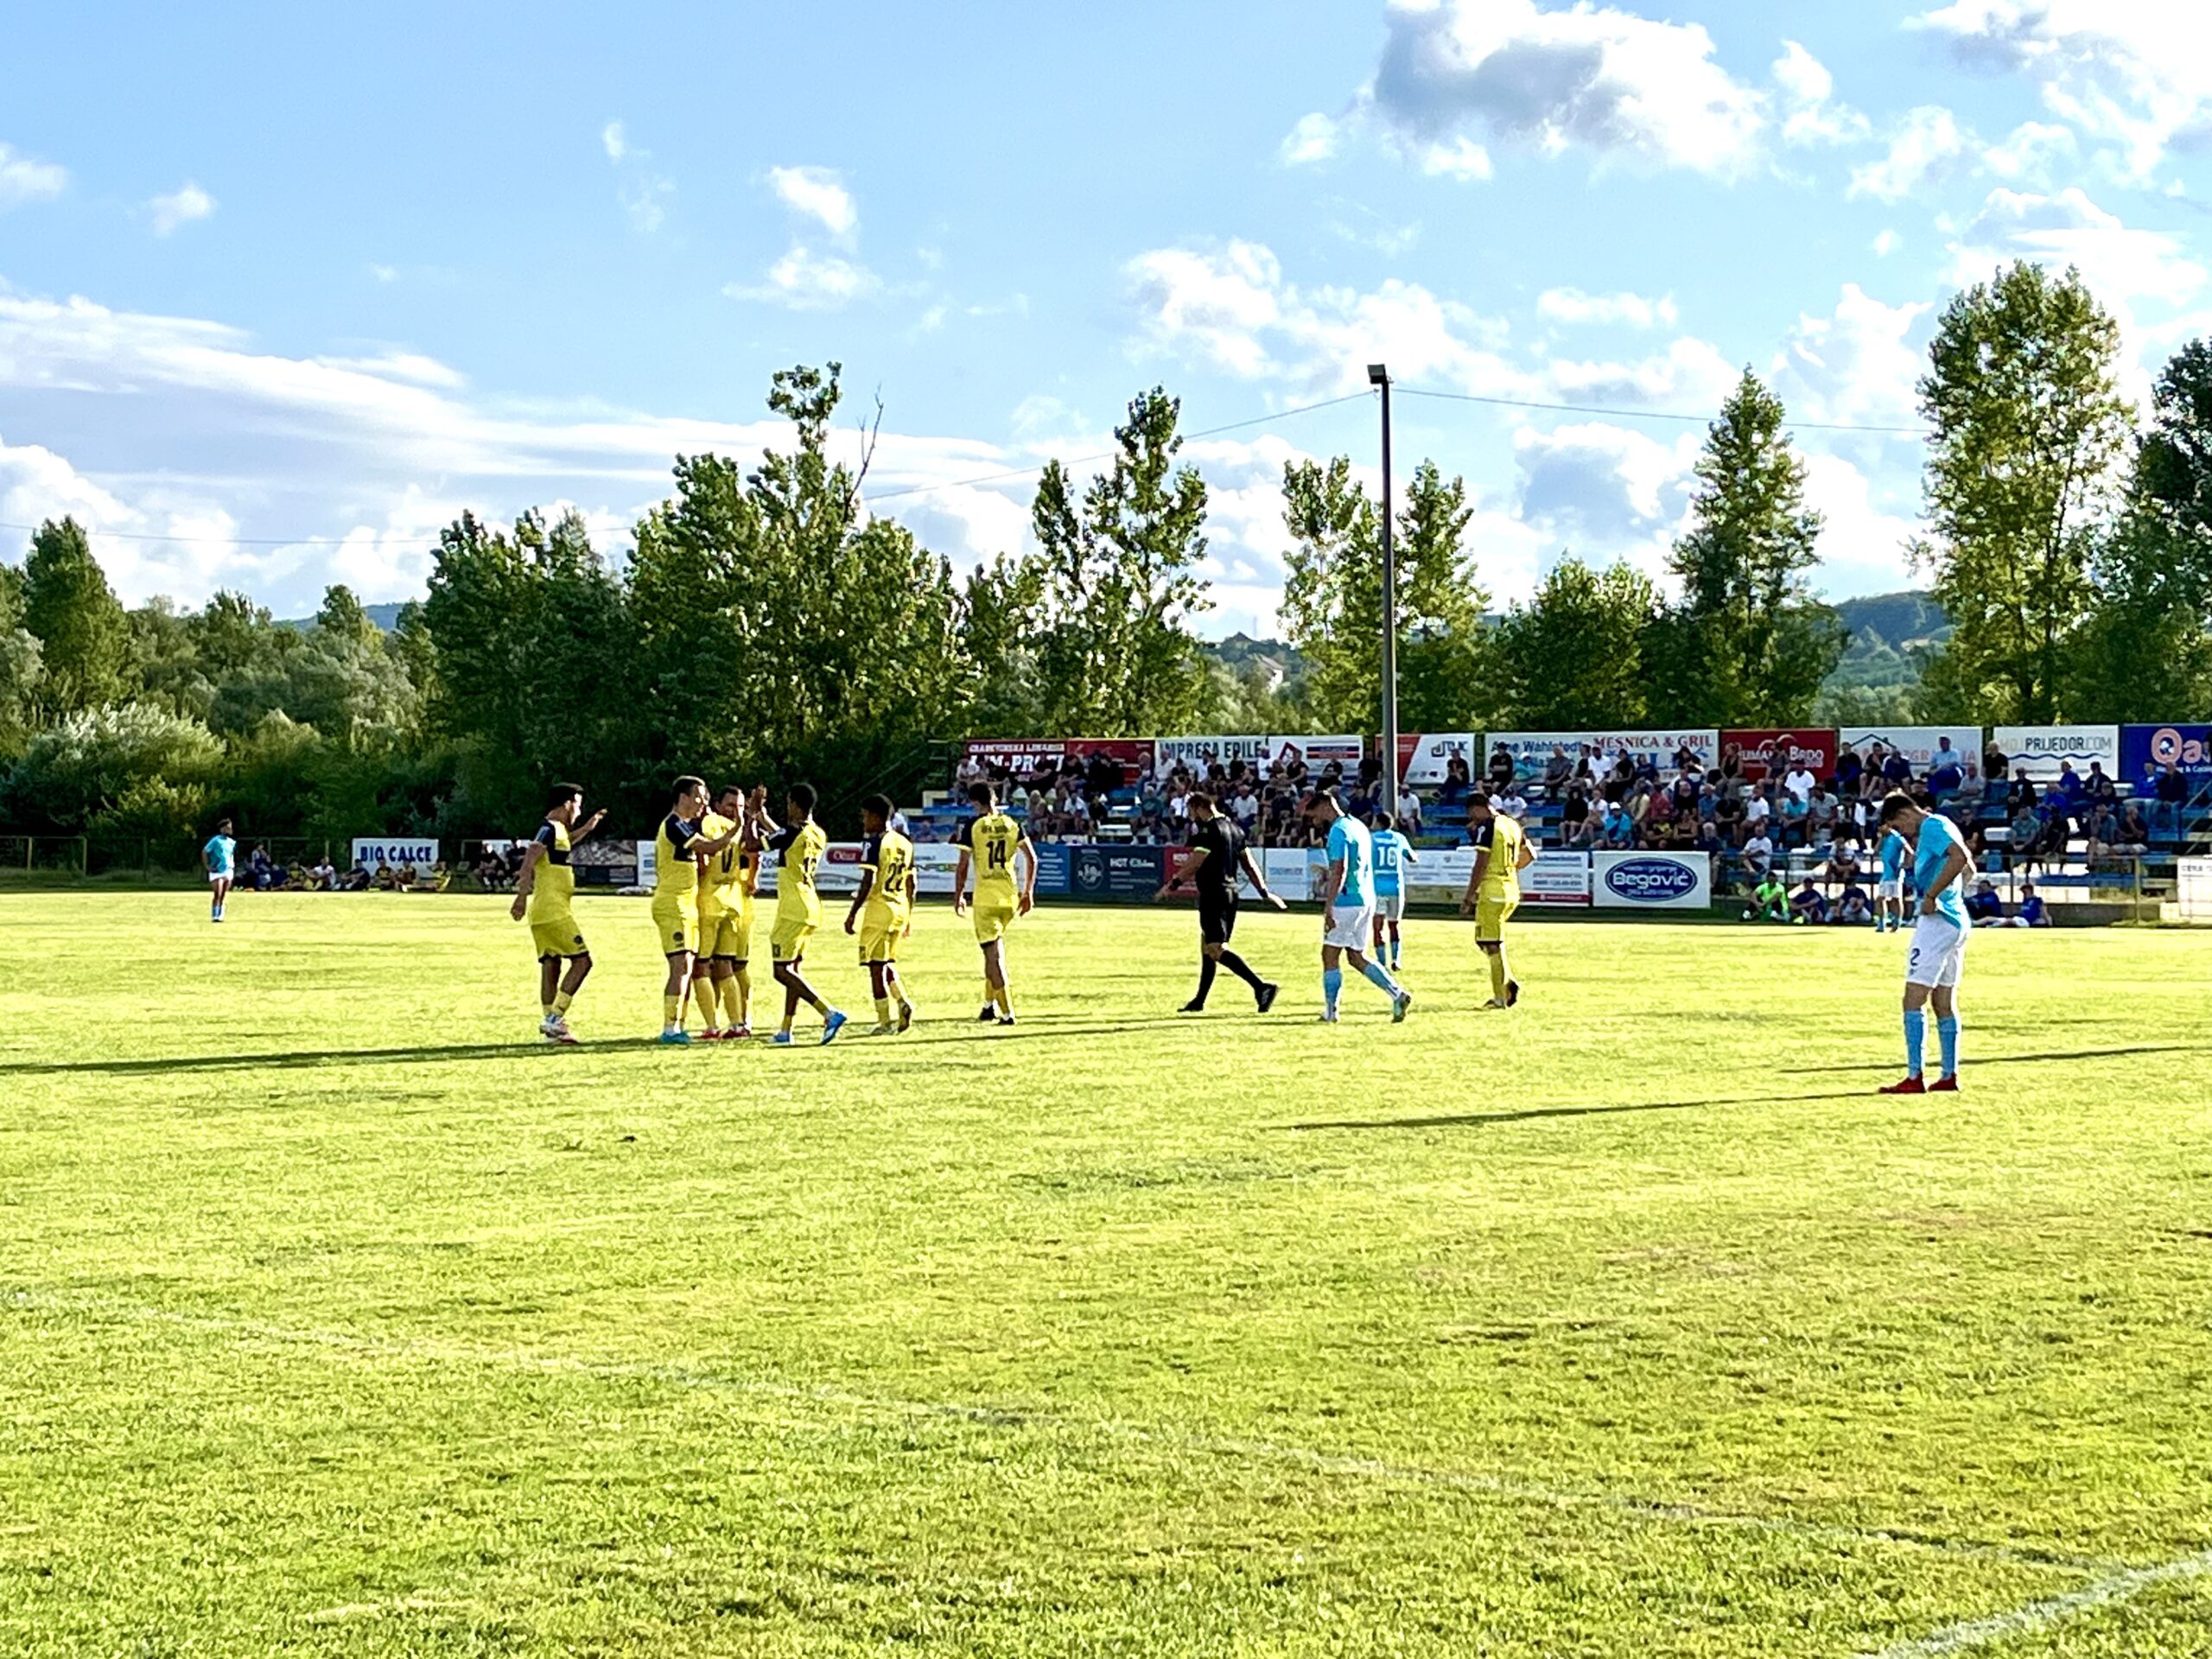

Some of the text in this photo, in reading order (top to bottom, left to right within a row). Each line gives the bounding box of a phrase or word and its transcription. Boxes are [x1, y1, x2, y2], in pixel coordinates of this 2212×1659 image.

[1593, 736, 1659, 748] MESNICA
[1663, 736, 1674, 747] &
[360, 846, 431, 862] BIO CALCE
[986, 839, 1007, 870] 14
[1377, 846, 1397, 867] 16
[1612, 870, 1689, 890] Begović
[1910, 947, 1921, 967] 2
